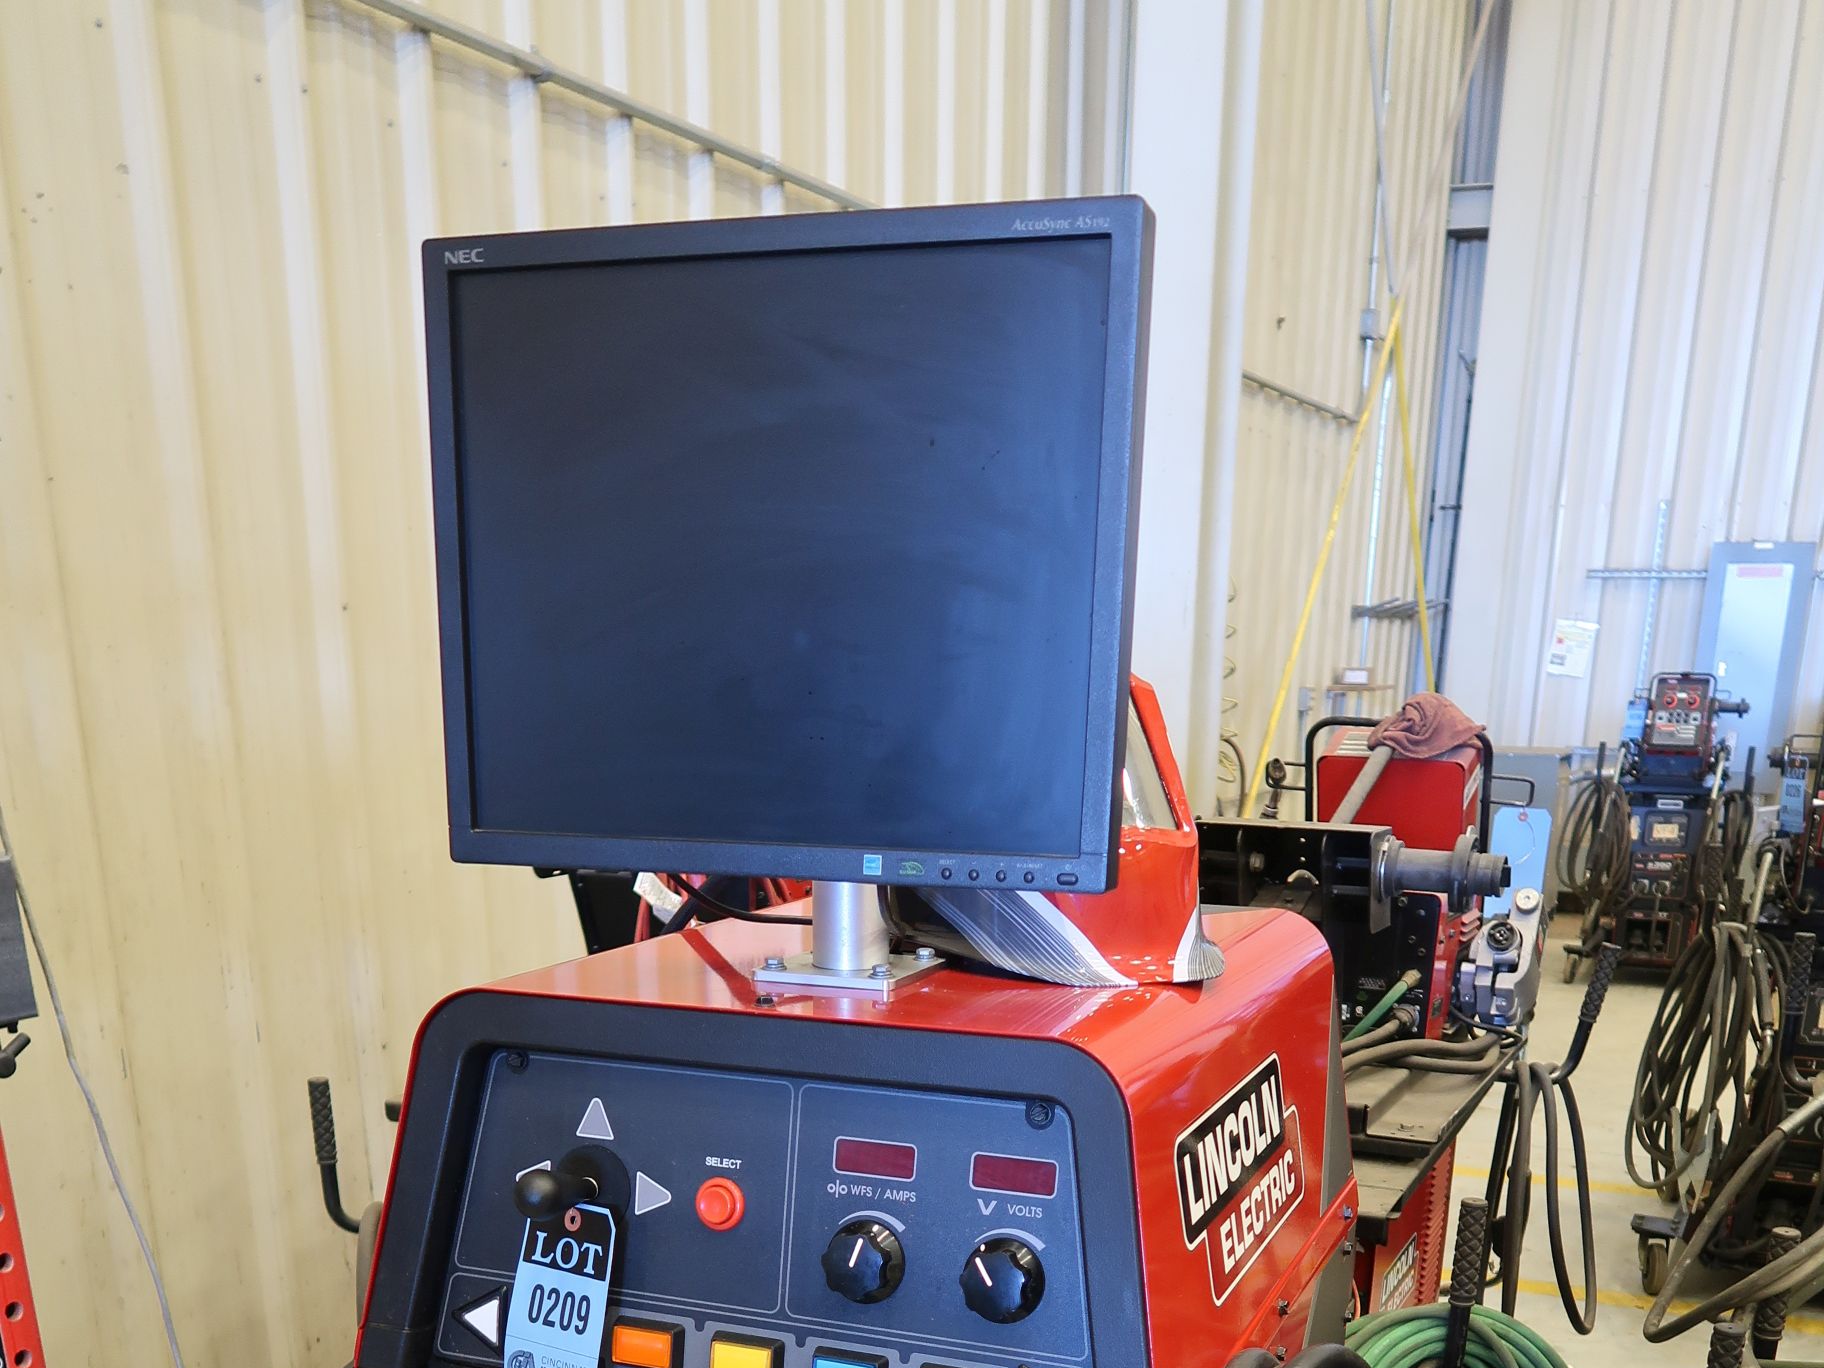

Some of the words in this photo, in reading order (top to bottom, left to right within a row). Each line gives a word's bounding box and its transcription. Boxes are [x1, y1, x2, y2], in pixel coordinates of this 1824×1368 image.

[444, 248, 485, 265] NEC
[705, 1156, 742, 1170] SELECT
[1183, 1075, 1281, 1226] LINCOLN
[850, 1184, 873, 1197] WFS
[884, 1189, 917, 1203] AMPS
[1007, 1203, 1043, 1219] VOLTS
[1219, 1148, 1295, 1275] ELECTRIC
[531, 1230, 603, 1275] LOT
[528, 1284, 591, 1335] 0209
